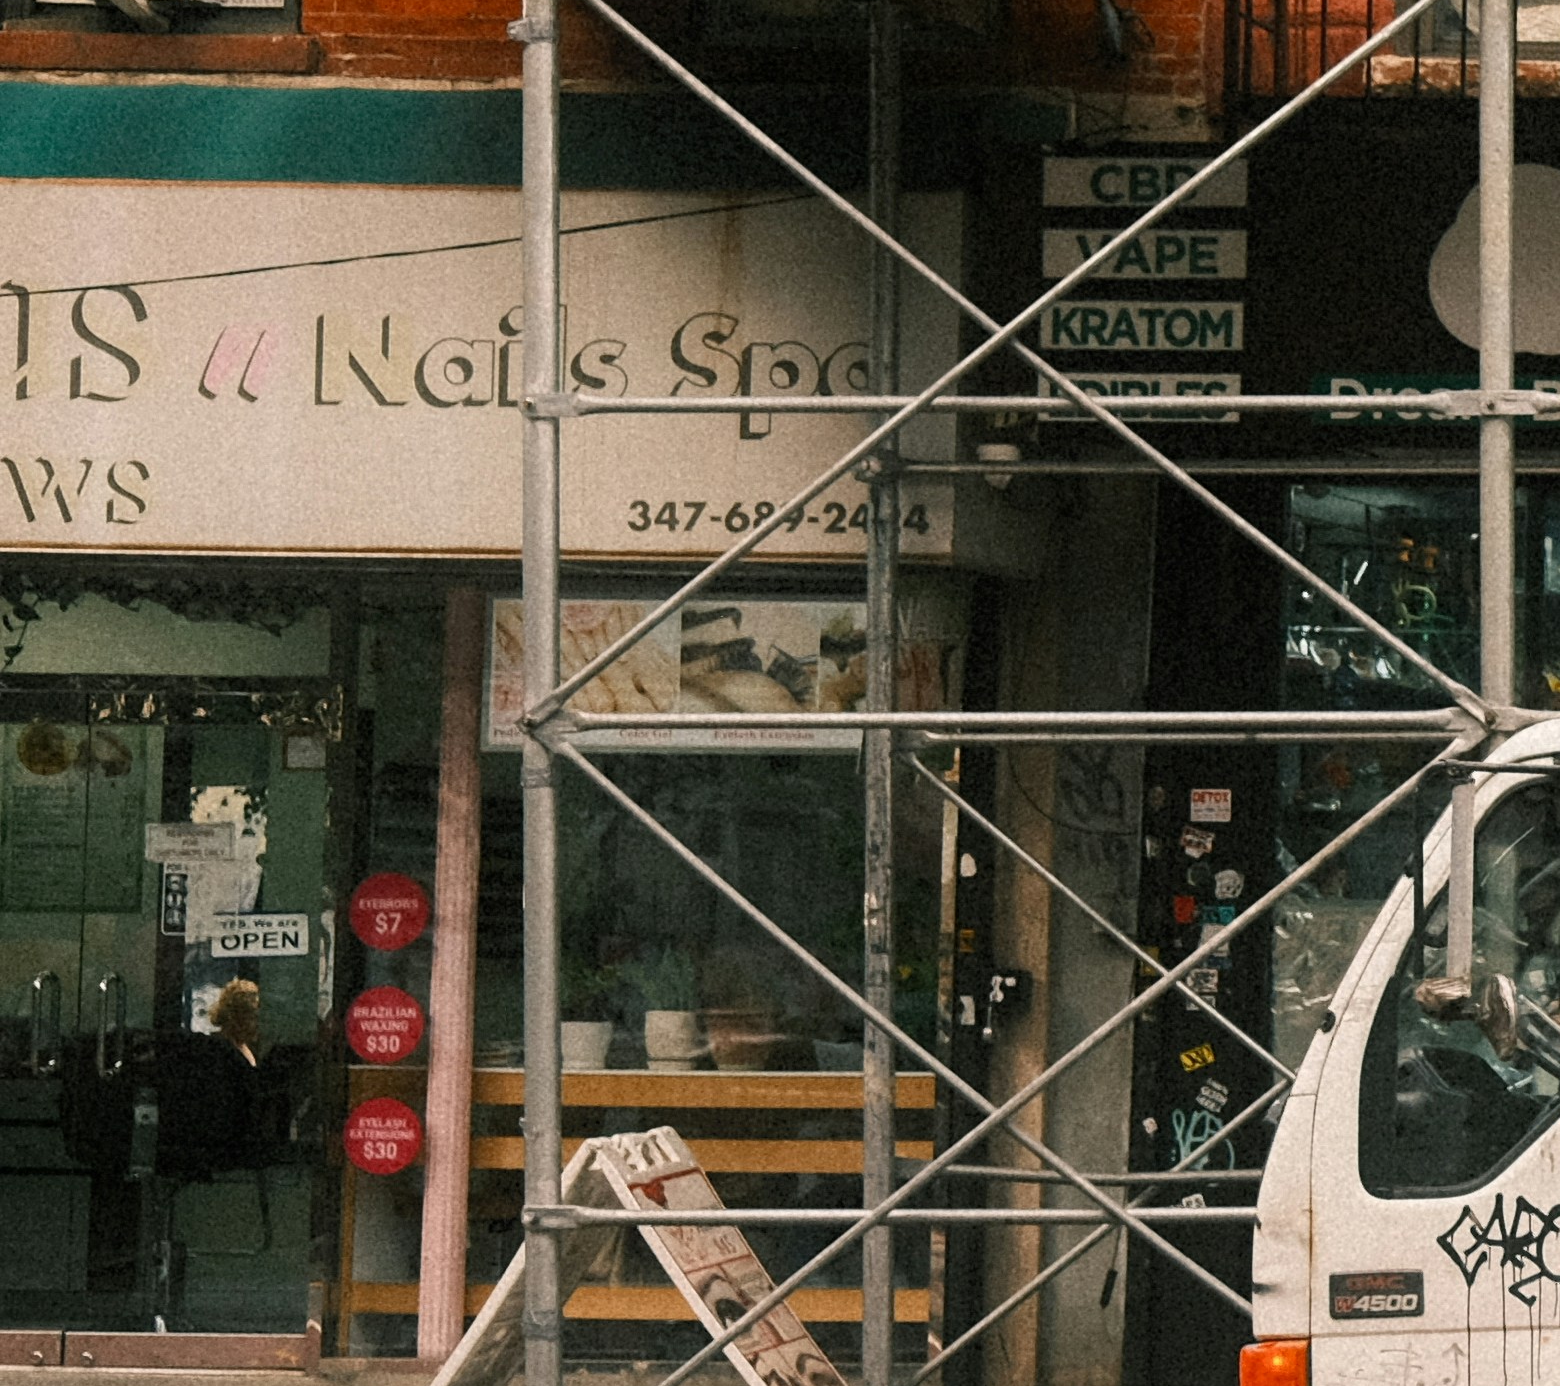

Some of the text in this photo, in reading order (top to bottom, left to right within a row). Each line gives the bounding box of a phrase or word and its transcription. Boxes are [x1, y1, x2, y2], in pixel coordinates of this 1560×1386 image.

[1090, 164, 1199, 203] CBD
[1076, 235, 1220, 274] VAPE
[1051, 308, 1233, 348] KRATOM
[313, 303, 629, 409] Nais
[375, 912, 401, 935] $7
[220, 931, 299, 951] OPEN
[366, 1035, 401, 1054] $30
[363, 1141, 398, 1160] $30
[1347, 1275, 1406, 1290] GMC
[1335, 1294, 1419, 1313] W4500
